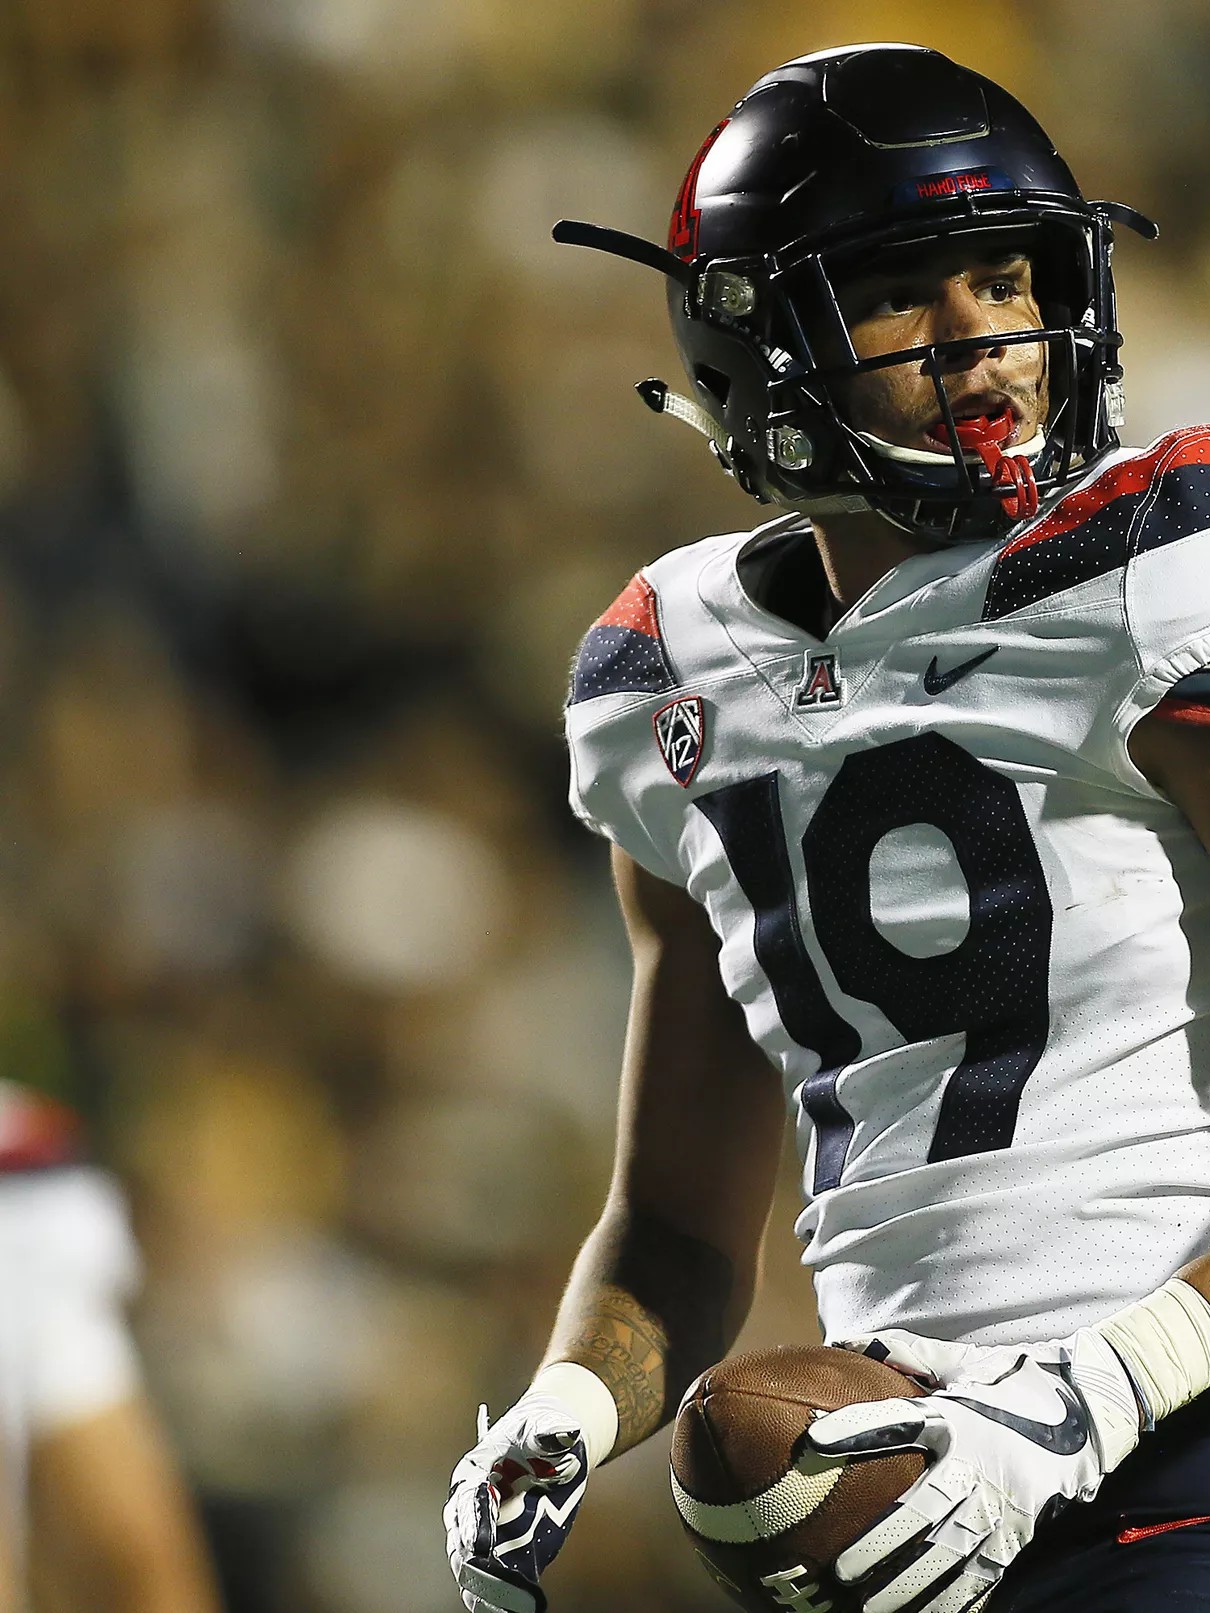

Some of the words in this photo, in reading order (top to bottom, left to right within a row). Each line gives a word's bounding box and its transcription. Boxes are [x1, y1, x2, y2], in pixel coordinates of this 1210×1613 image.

[915, 177, 957, 198] HARD
[956, 173, 992, 191] EDGE
[792, 650, 847, 712] A
[671, 734, 695, 772] 12
[692, 731, 1053, 1195] 19
